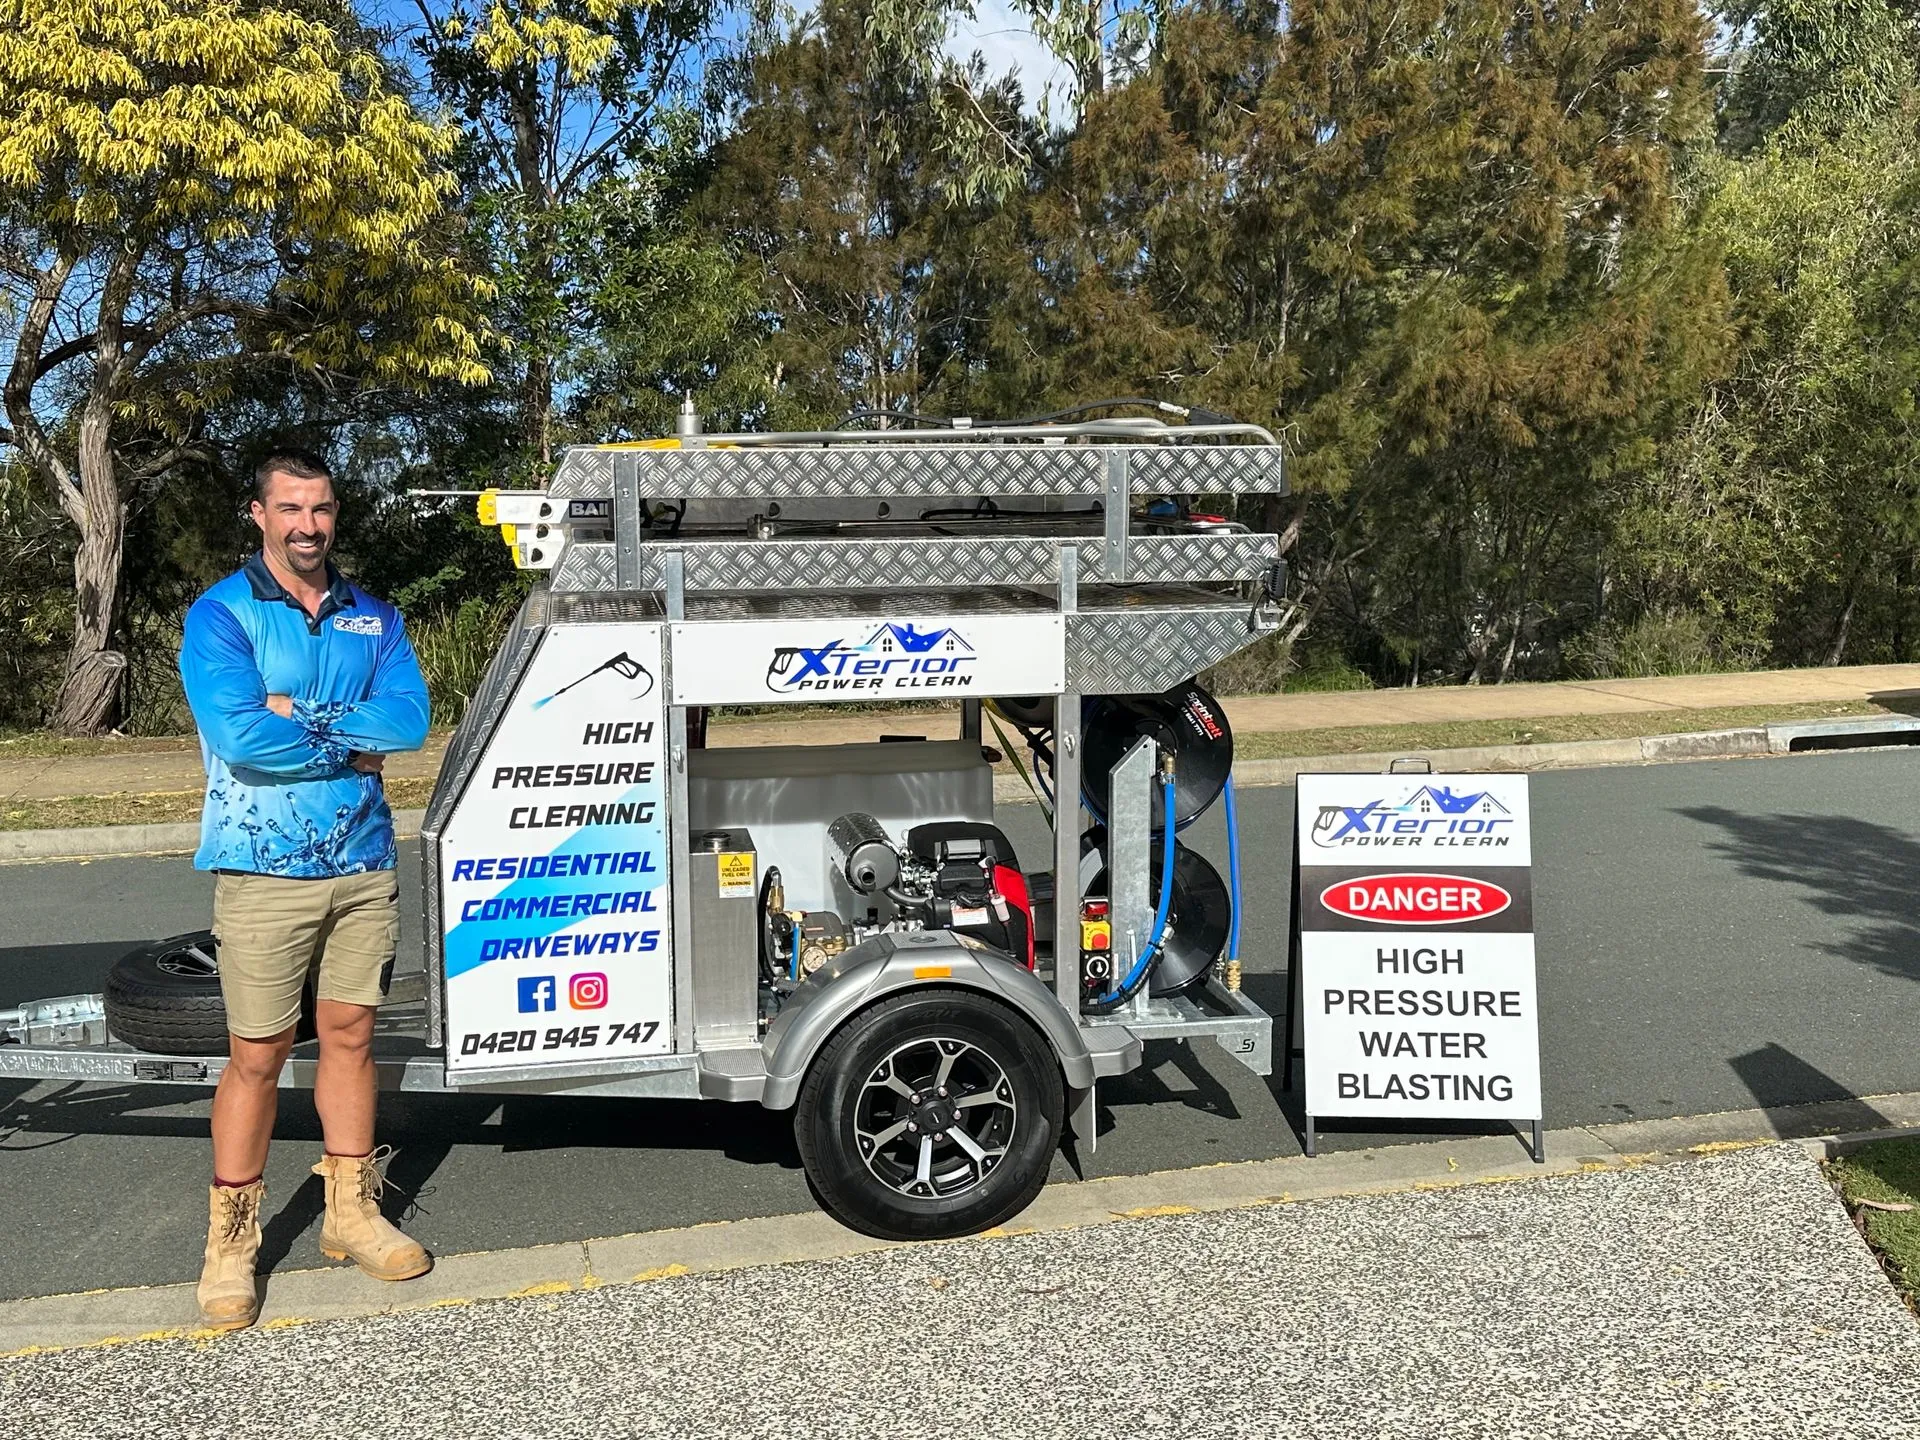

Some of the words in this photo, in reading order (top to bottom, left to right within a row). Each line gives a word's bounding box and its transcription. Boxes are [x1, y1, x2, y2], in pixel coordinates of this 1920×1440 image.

[798, 678, 884, 691] POWER
[895, 675, 973, 688] CLEAN
[582, 721, 654, 745] HIGH
[491, 761, 655, 789] PRESSURE
[508, 802, 656, 829] CLEANING
[1341, 836, 1421, 847] POWER
[1434, 836, 1510, 847] CLEAN
[451, 851, 656, 882] RESIDENTIAL
[460, 890, 657, 922] COMMERCIAL
[1348, 887, 1484, 912] DANGER
[479, 930, 660, 962] DRIVEWAYS
[1376, 948, 1464, 974] HIGH
[1324, 989, 1522, 1017] PRESSURE
[461, 1028, 536, 1055] 0420
[542, 1025, 599, 1052] 945
[606, 1021, 660, 1047] 747
[1359, 1031, 1488, 1059] WATER
[1338, 1073, 1513, 1102] BLASTING
